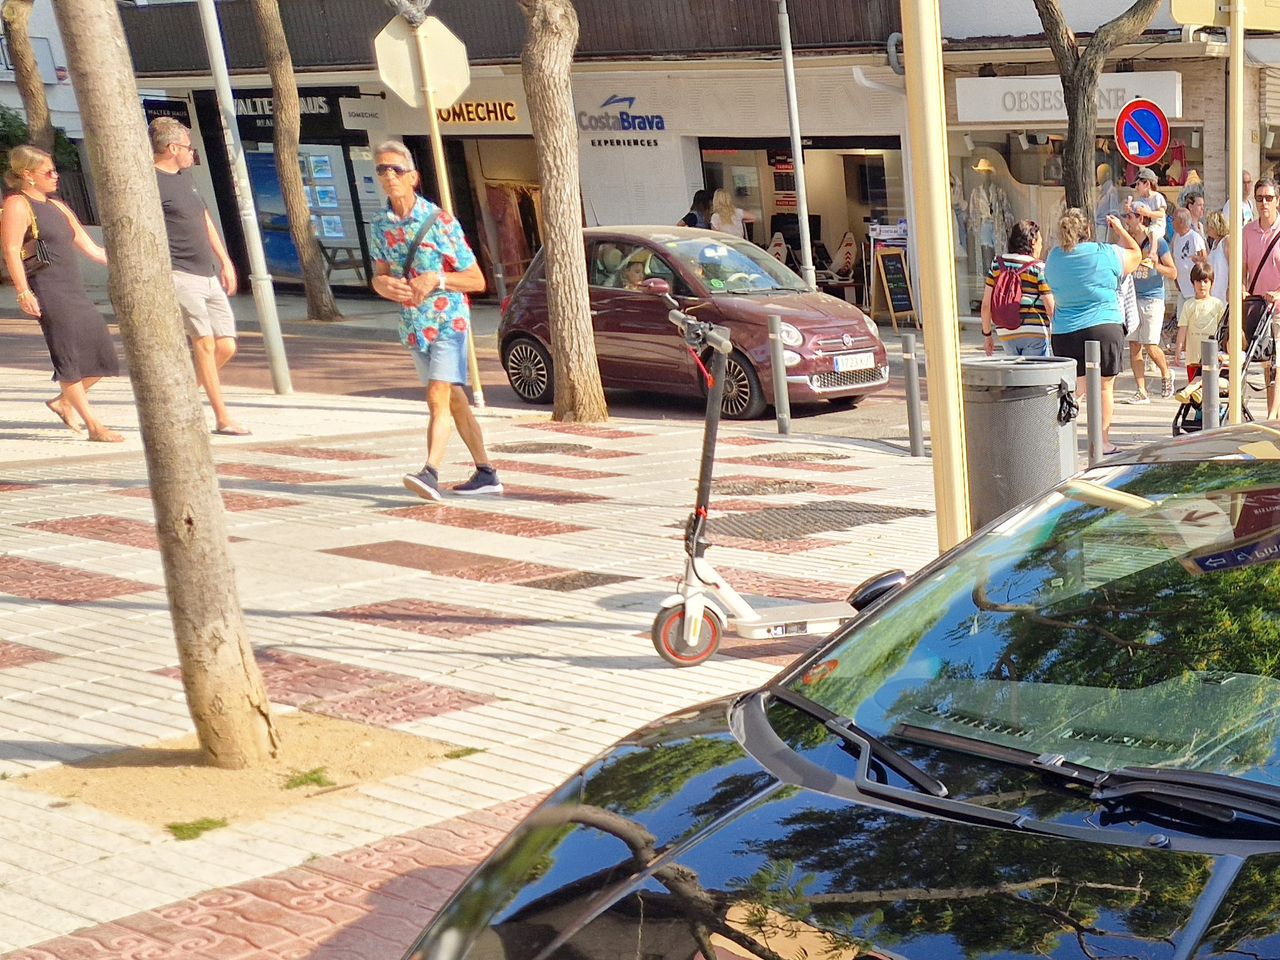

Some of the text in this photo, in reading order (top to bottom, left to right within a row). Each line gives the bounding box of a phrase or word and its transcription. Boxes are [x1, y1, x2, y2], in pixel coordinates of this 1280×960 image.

[234, 97, 330, 115] ALTE AUS
[1003, 88, 1126, 112] OBSESNE
[436, 102, 516, 122] OMECHIC
[591, 139, 658, 147] EXPERIENCES
